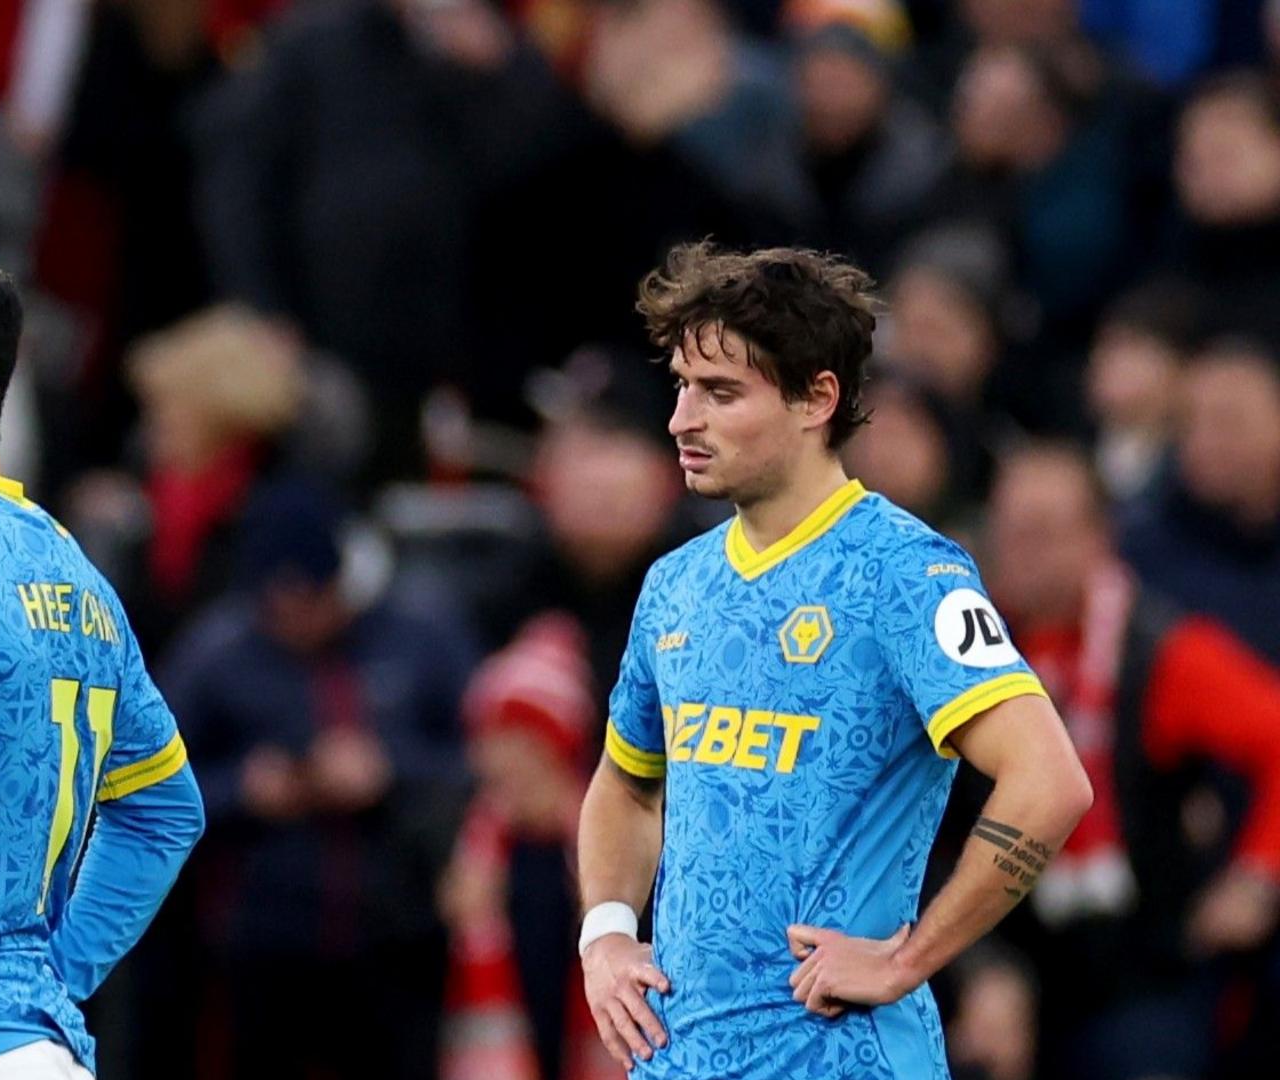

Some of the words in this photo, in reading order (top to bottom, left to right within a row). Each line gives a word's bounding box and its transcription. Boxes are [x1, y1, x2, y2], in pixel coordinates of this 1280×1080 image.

[17, 582, 73, 633] HEE
[957, 607, 1004, 657] JD
[37, 678, 117, 915] 11
